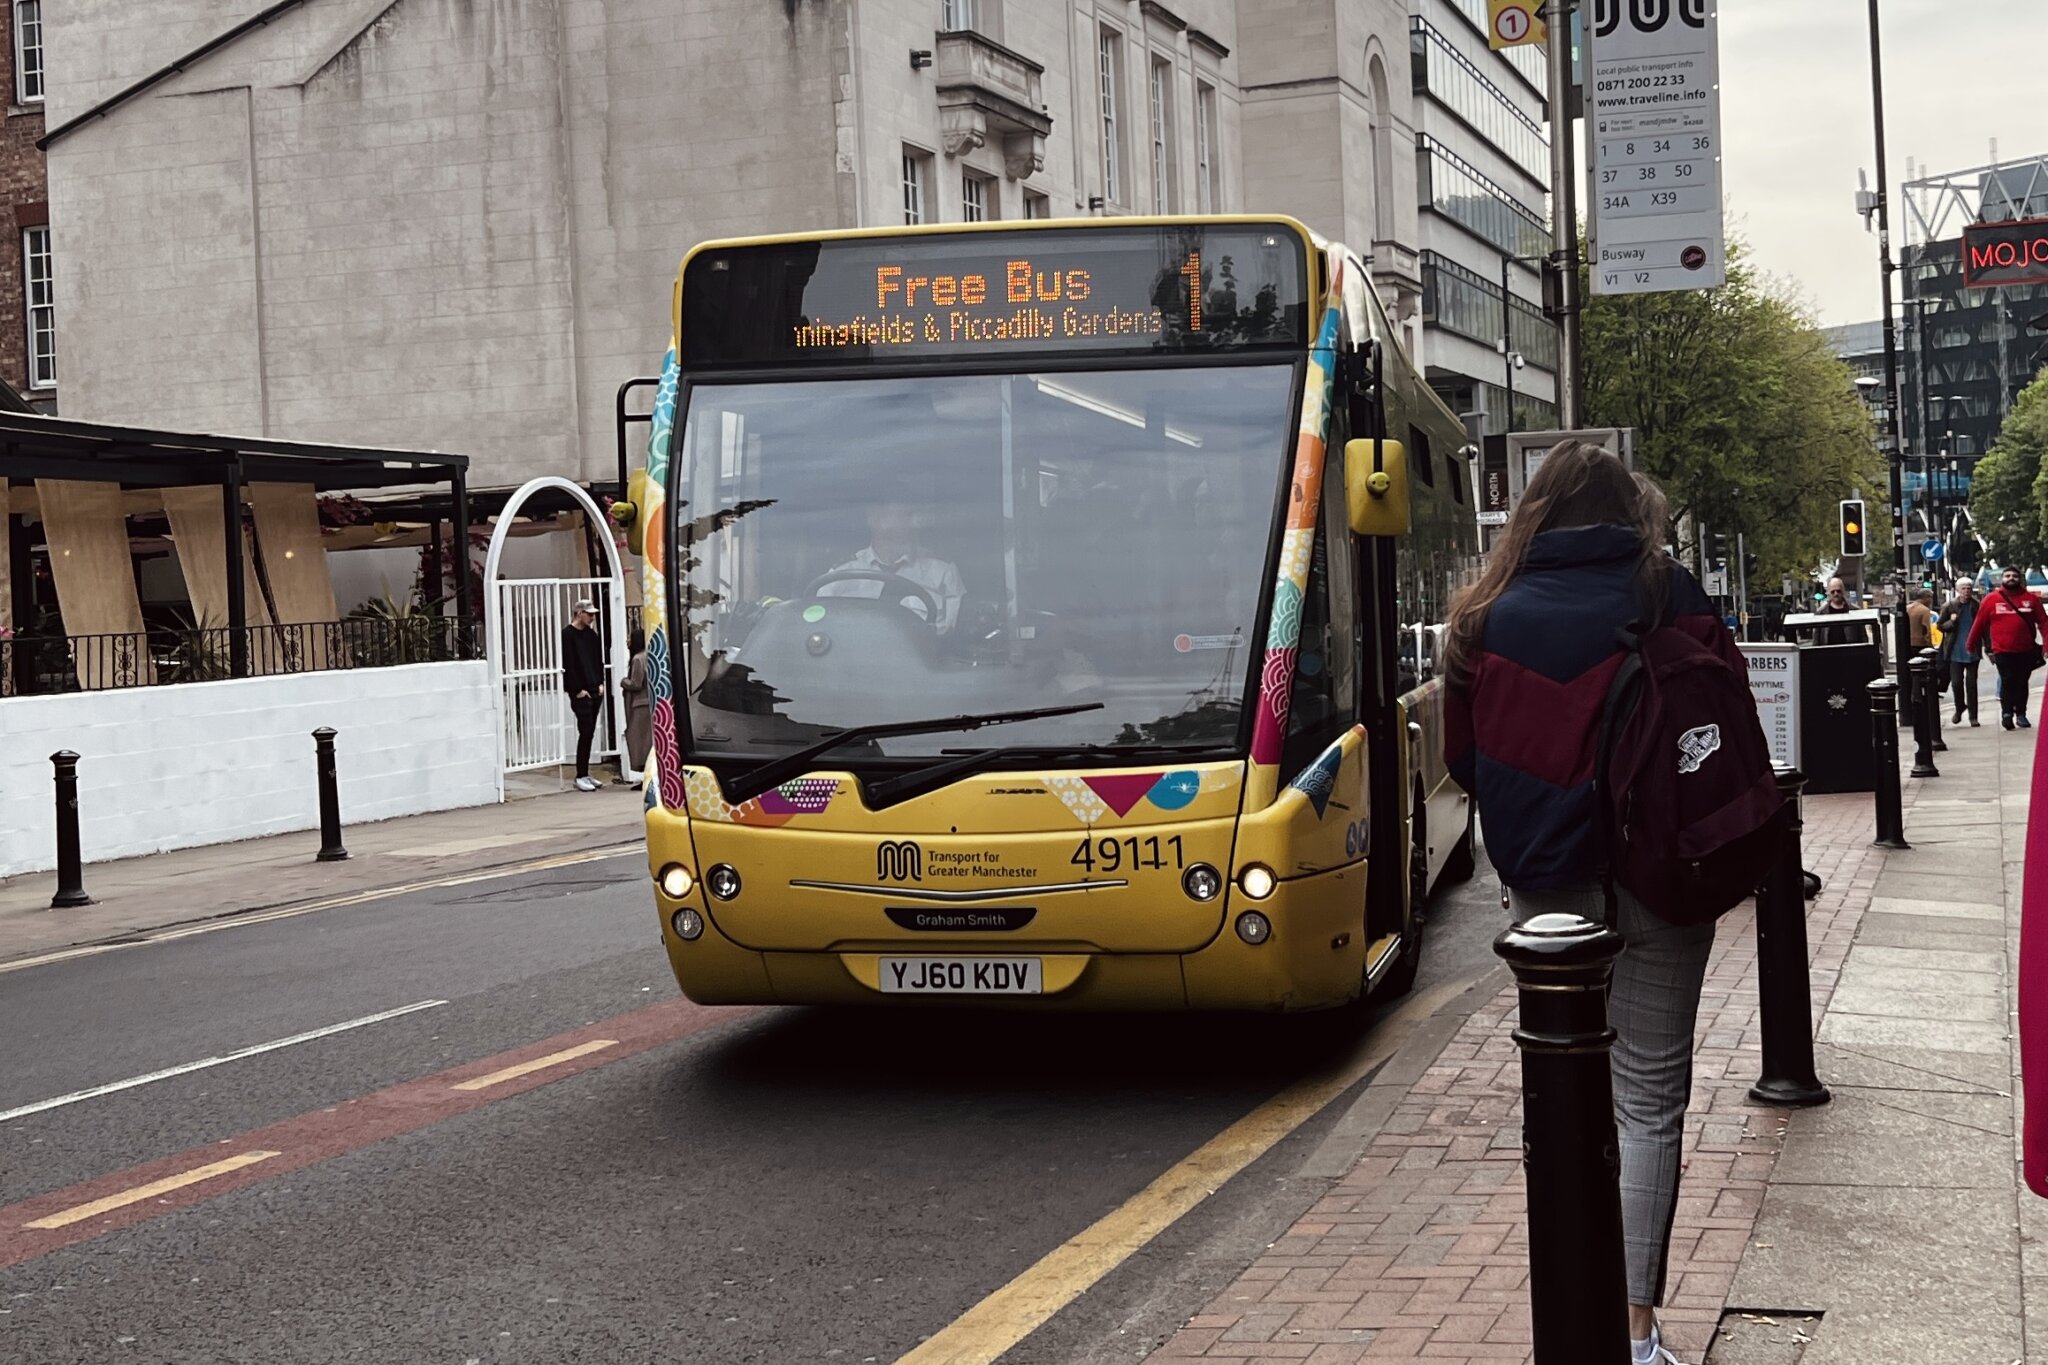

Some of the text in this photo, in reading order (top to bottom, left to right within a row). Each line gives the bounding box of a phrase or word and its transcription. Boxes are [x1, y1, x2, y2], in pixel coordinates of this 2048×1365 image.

[1506, 14, 1517, 34] 1
[1597, 60, 1693, 76] Local public transport info
[1597, 74, 1685, 91] 0871 200 22 33
[1597, 89, 1706, 107] www.traveline.info
[1601, 136, 1710, 157] 1 8 34 36
[1602, 164, 1692, 183] 37 38 50
[1603, 191, 1677, 210] 34A X39
[1602, 249, 1646, 261] Busway
[1971, 238, 2048, 270] MOJO
[877, 260, 1090, 308] Free Bus
[1604, 272, 1650, 285] V1 V2
[1180, 252, 1200, 331] 1
[924, 312, 940, 342] &
[950, 308, 1054, 341] Piccadilly
[1063, 304, 1162, 337] Gardens
[1489, 472, 1500, 505] NORTH
[1746, 657, 1788, 670] ARBERS
[1749, 681, 1785, 689] ANYTIME
[928, 850, 999, 865] Transport for
[1070, 835, 1183, 872] 49111
[928, 865, 1037, 877] Greater Manchester
[916, 914, 1006, 926] Graham Smith
[891, 962, 1028, 990] YJ60 KDV
